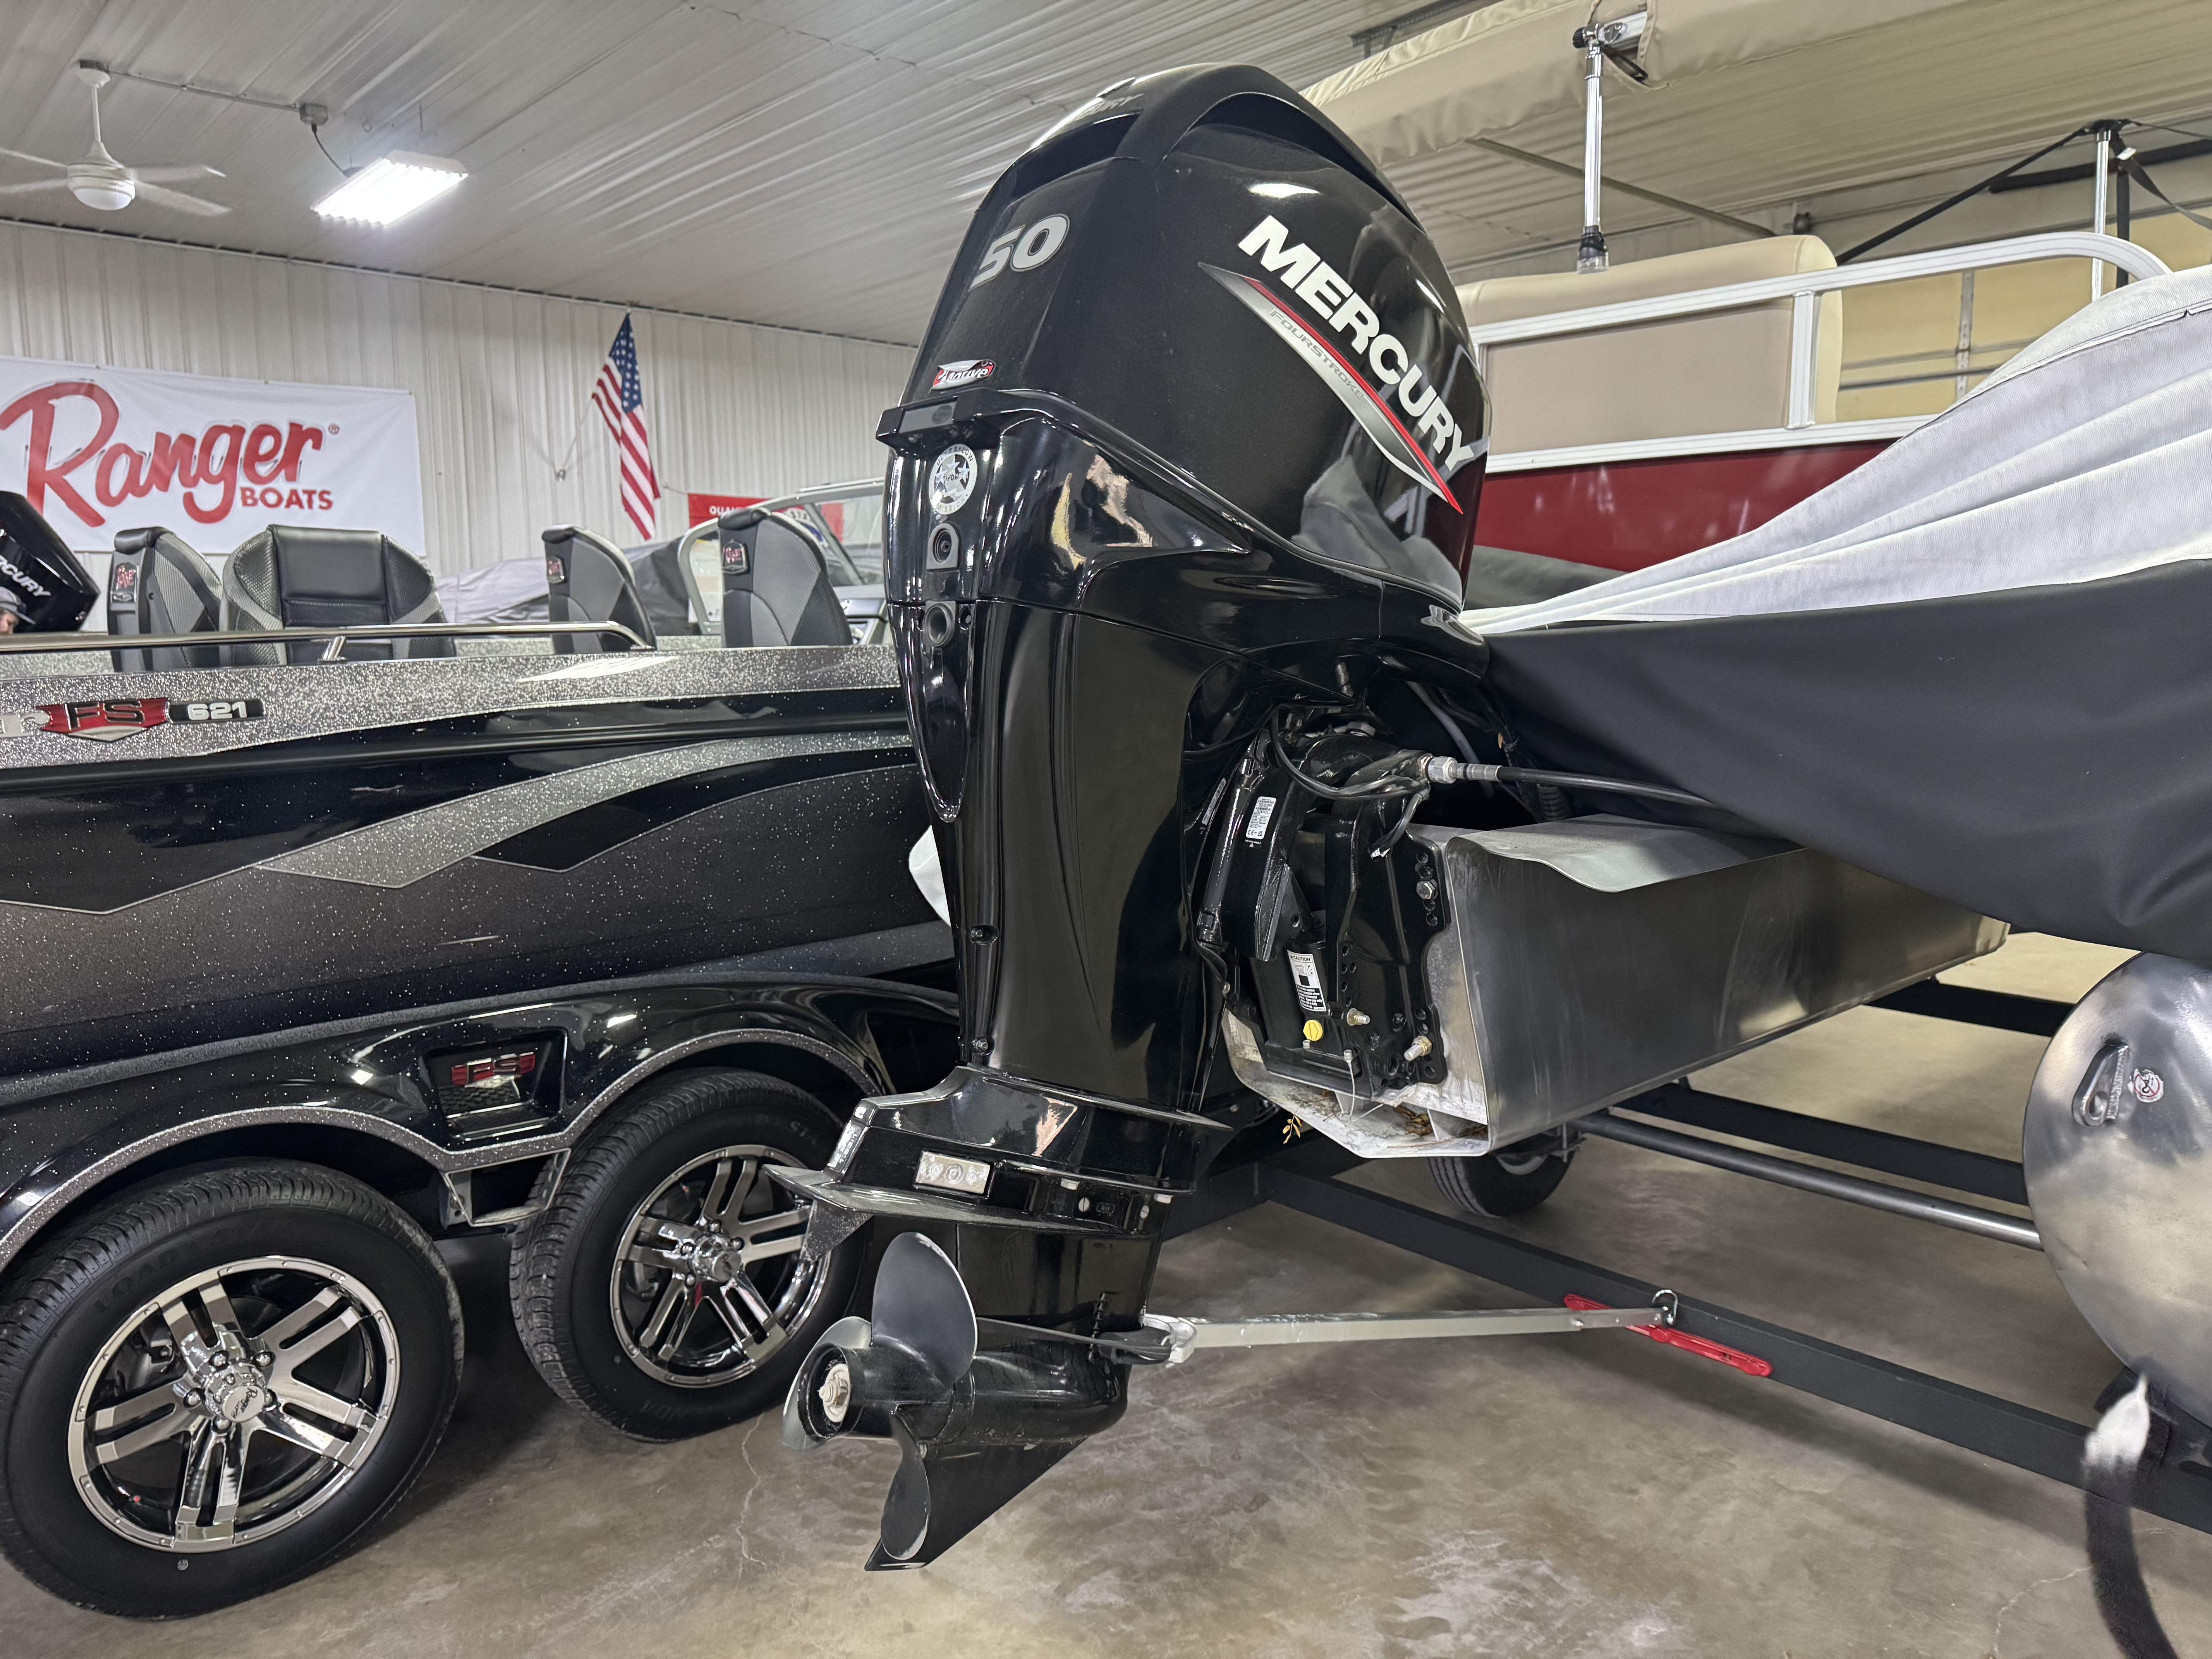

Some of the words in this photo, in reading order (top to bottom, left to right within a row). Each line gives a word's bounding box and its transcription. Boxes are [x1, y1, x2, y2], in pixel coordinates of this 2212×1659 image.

[969, 213, 1070, 292] 50
[1238, 215, 1474, 471] MERCURY
[1270, 309, 1364, 399] FOURSTROKE
[0, 381, 324, 527] Ranger
[936, 446, 958, 466] ULTRA
[961, 447, 974, 462] LOW
[240, 486, 333, 510] BOATS
[65, 700, 146, 732] FS
[187, 701, 248, 720] 621
[467, 1053, 522, 1084] FS
[240, 1388, 258, 1413] Ranger
